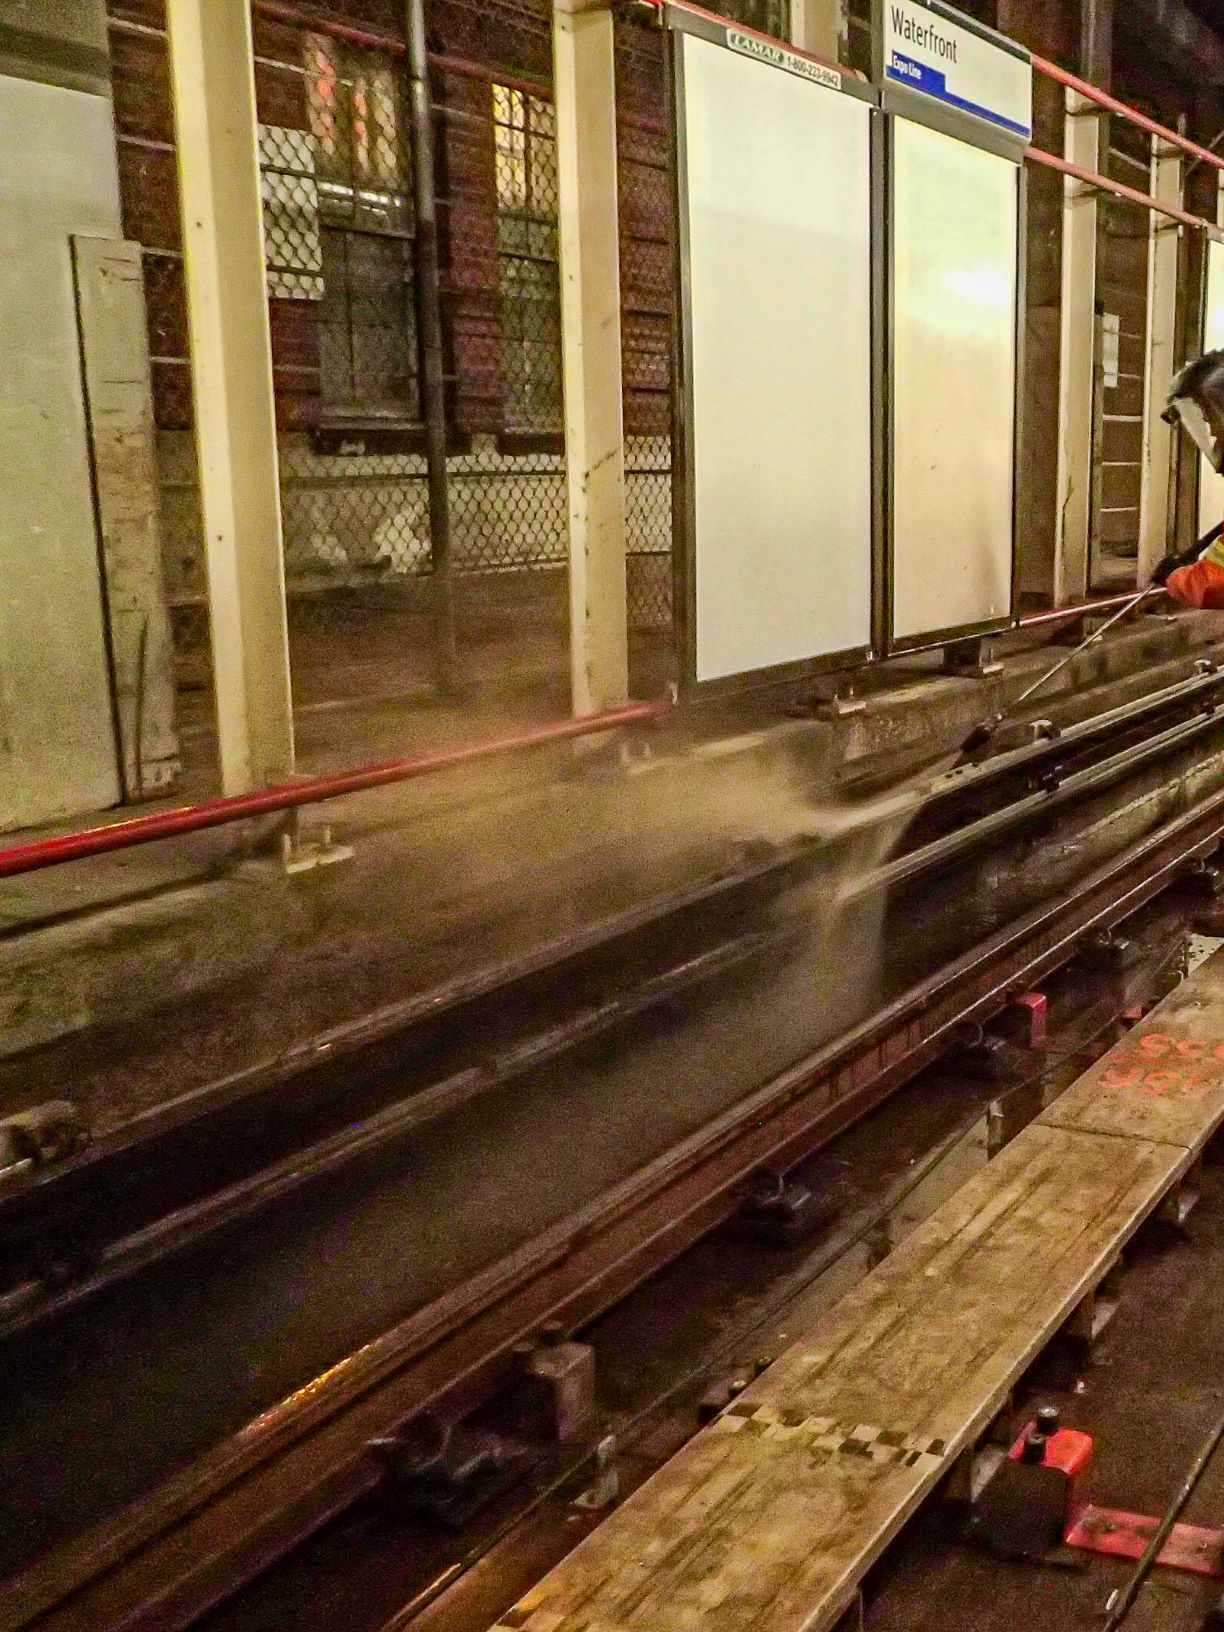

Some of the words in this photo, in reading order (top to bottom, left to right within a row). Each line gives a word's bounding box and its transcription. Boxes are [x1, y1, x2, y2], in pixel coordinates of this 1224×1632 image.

[733, 34, 782, 62] LAMAR
[891, 4, 958, 64] Waterfront
[892, 54, 908, 74] Expo
[908, 62, 922, 80] Line
